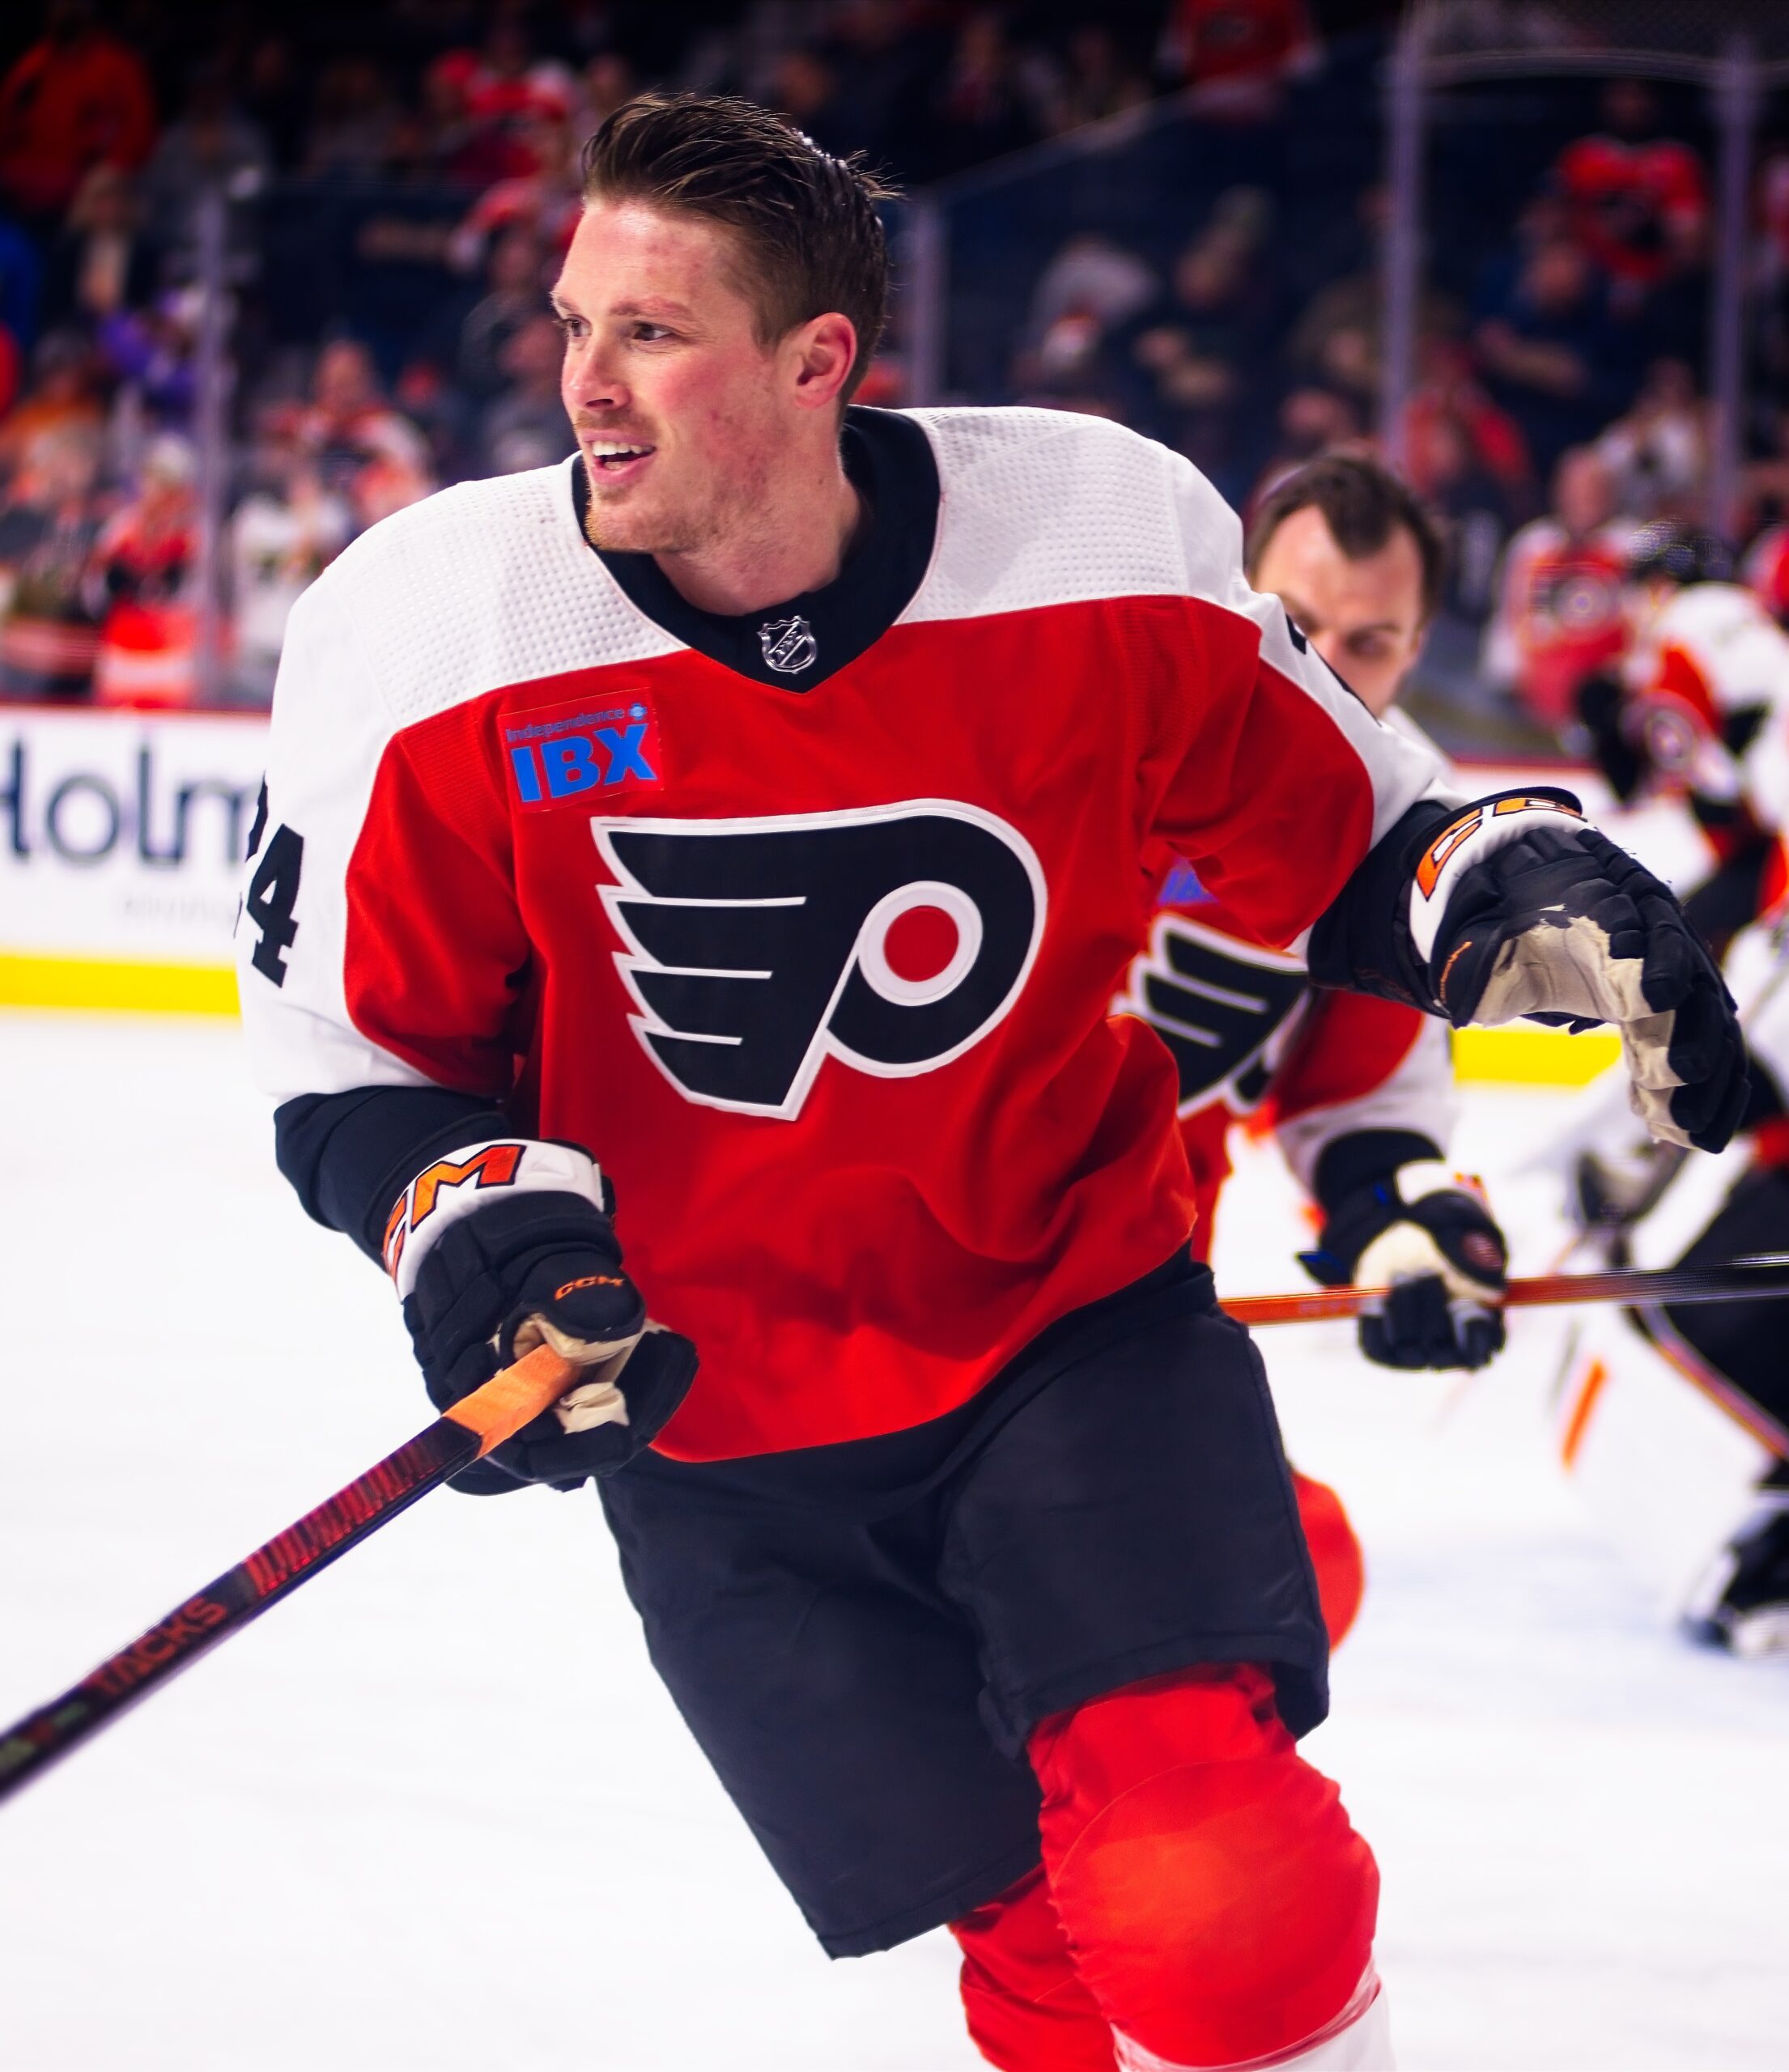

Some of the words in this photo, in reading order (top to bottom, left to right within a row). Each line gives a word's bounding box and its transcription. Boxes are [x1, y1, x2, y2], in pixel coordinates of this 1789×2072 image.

[505, 707, 625, 743] Independence
[510, 723, 658, 803] IBX
[234, 771, 304, 988] 4
[555, 1276, 623, 1301] CCM
[83, 1596, 227, 1696] TACKS
